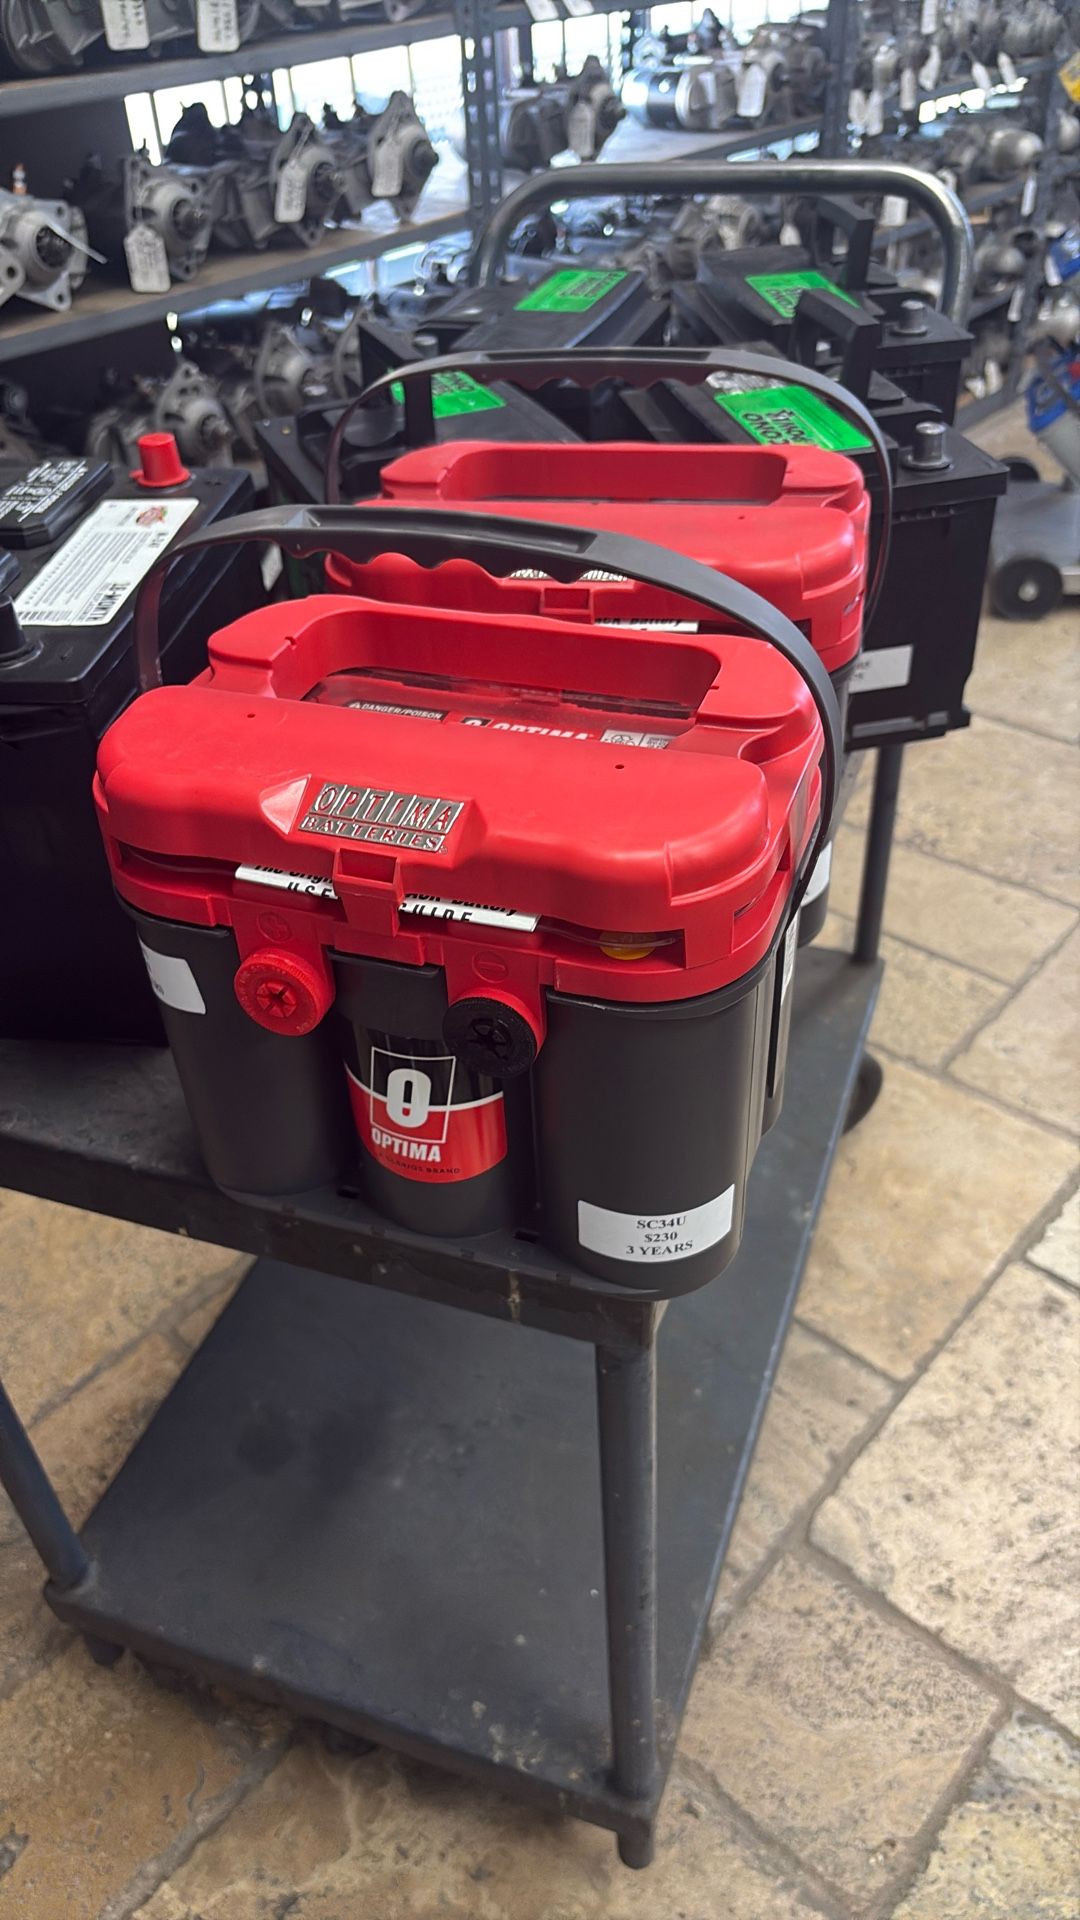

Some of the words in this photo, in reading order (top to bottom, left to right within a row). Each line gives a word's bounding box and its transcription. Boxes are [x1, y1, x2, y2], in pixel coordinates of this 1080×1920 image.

[361, 703, 443, 720] DANGER/POISON
[313, 786, 460, 833] OPTIMA
[300, 815, 438, 851] BATTERIES
[371, 1127, 442, 1162] OPTIMA
[636, 1216, 687, 1229] SC34U
[644, 1231, 678, 1243] $230
[626, 1245, 634, 1255] 3
[639, 1240, 693, 1256] YEARS
